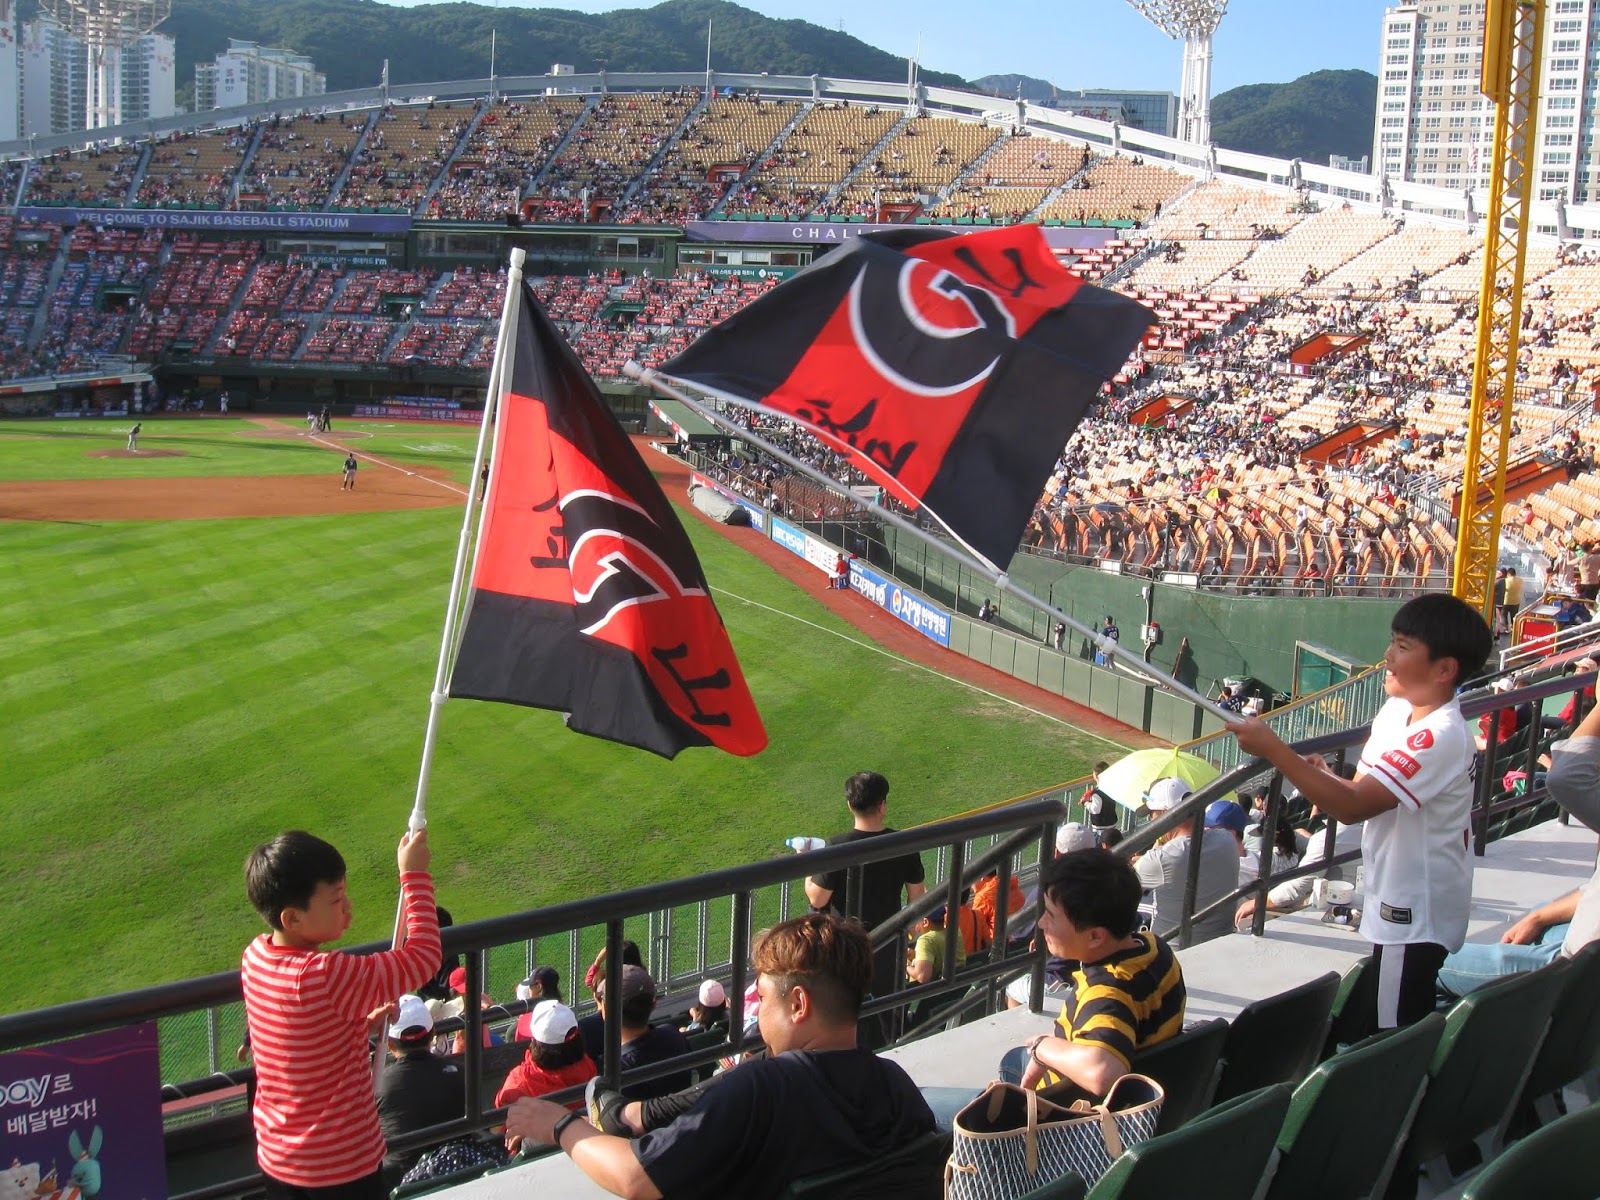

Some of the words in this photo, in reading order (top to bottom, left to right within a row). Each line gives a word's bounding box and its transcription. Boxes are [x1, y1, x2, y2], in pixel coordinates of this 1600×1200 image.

[76, 212, 145, 225] WELCOME
[149, 214, 167, 225] TO
[170, 214, 211, 226] SAJIK
[214, 215, 285, 227] BASEBALL
[289, 217, 350, 229] STADIUM
[1383, 750, 1417, 775] 롯데마트
[7, 1098, 97, 1135] 배달받자!
